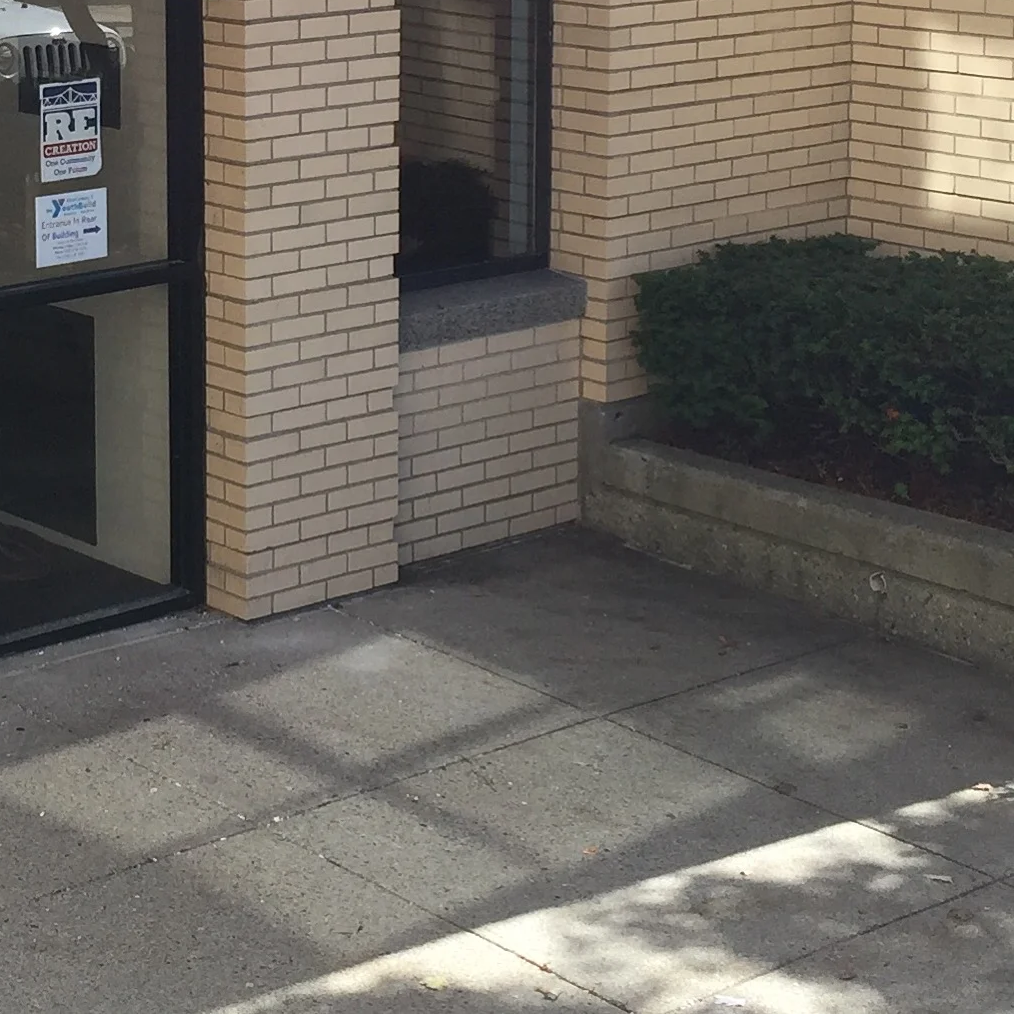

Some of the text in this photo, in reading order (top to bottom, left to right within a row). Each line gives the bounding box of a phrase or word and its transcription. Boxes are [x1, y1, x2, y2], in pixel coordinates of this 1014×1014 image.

[45, 108, 95, 141] RE
[45, 141, 96, 156] CREATION
[42, 220, 71, 229] Entrance
